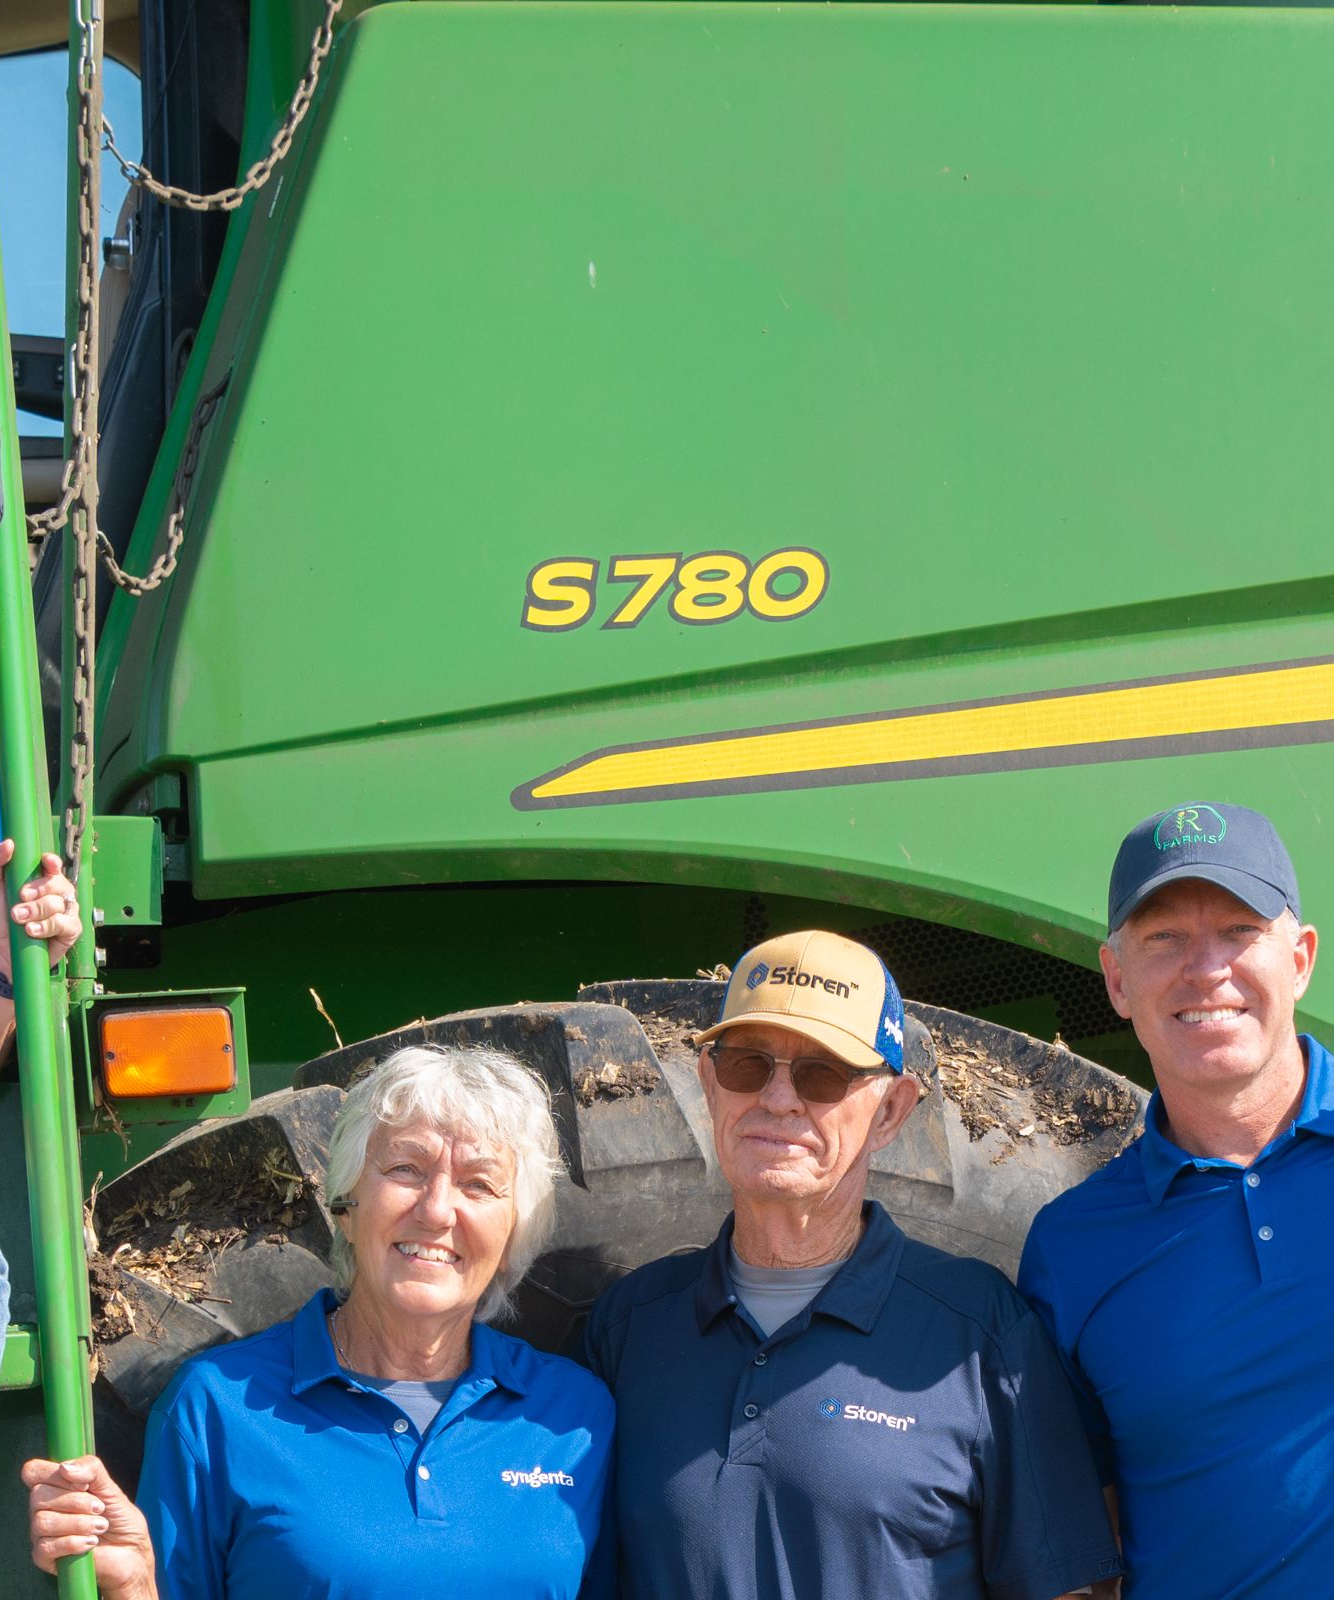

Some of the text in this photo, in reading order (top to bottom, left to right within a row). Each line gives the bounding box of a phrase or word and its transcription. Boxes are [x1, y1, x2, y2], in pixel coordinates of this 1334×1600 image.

[520, 546, 830, 633] S780
[1162, 834, 1217, 851] FARMS
[501, 1466, 574, 1488] syngenta
